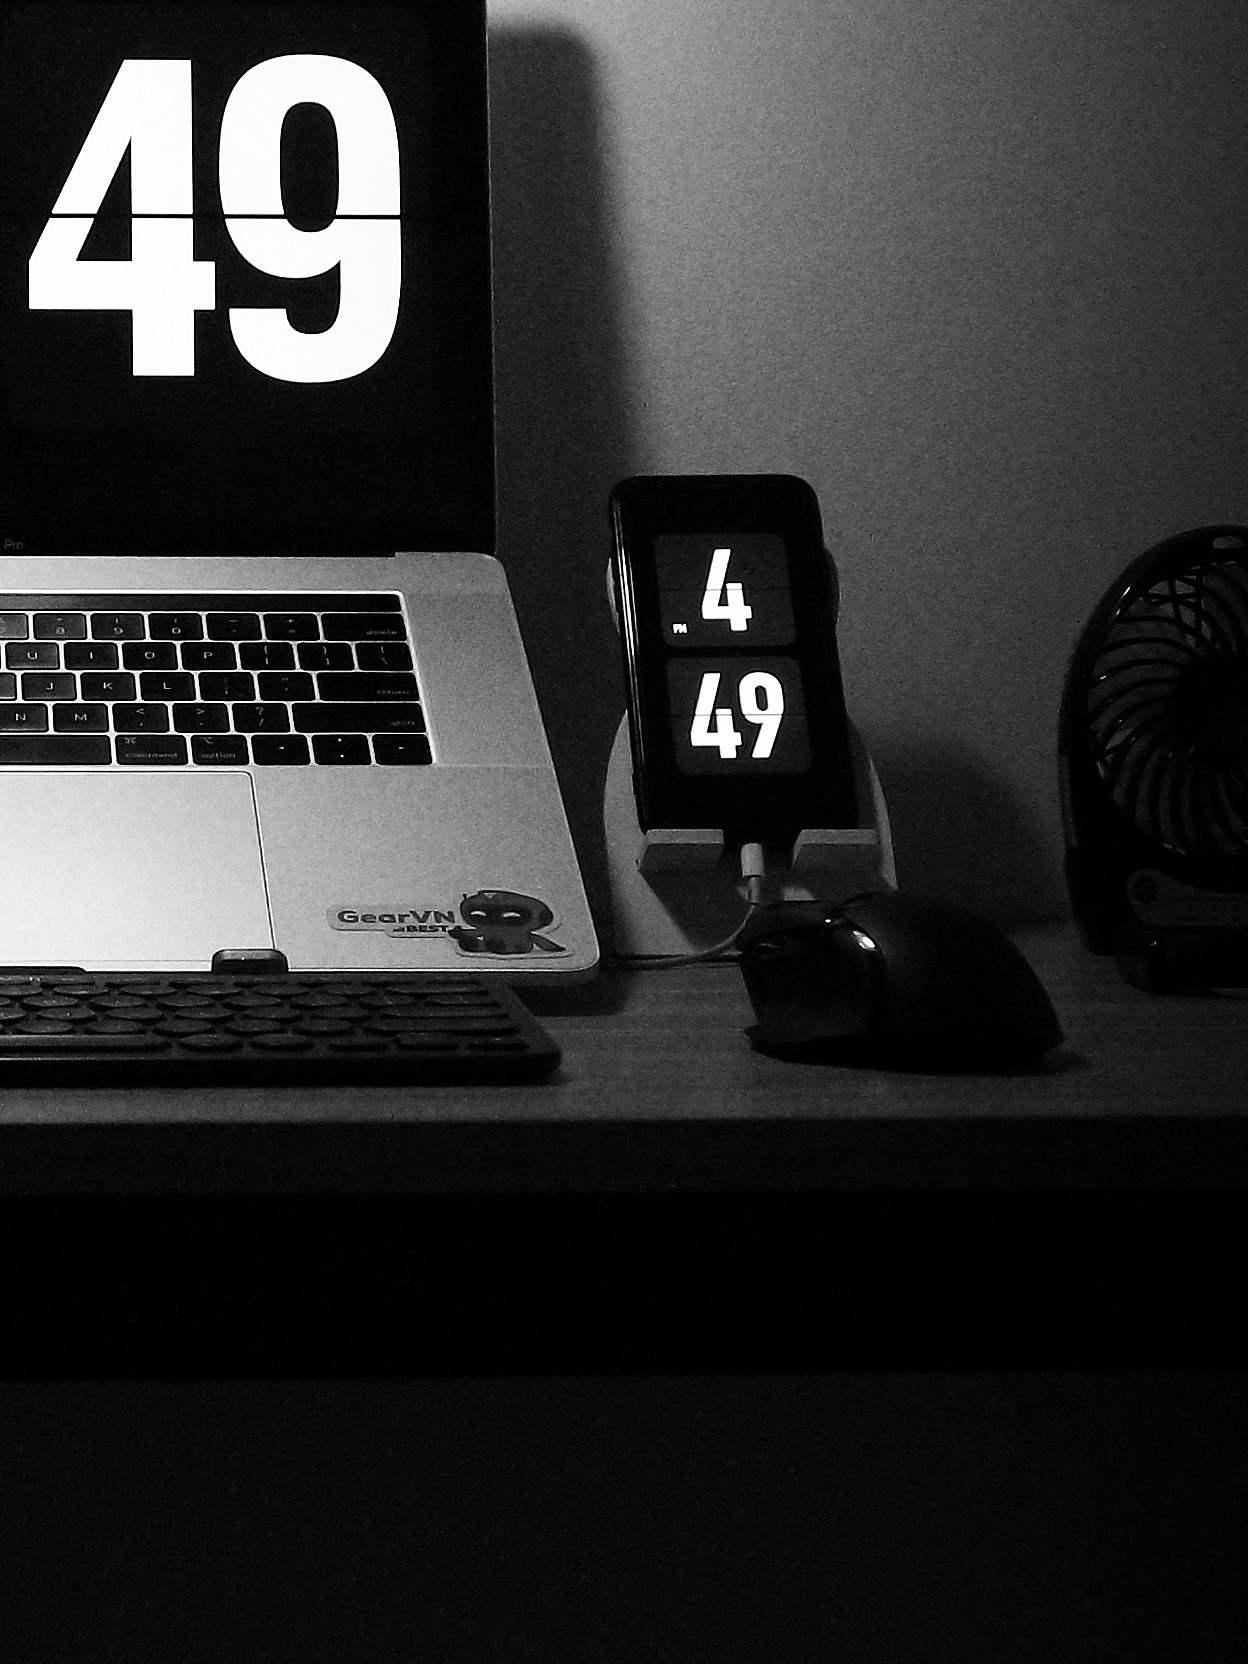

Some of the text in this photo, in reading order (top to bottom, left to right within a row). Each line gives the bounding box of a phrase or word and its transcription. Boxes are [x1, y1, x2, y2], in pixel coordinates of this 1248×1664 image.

[29, 54, 401, 383] 49
[4, 538, 24, 550] Pro
[702, 549, 752, 631] 4
[27, 651, 38, 660] U
[144, 650, 155, 660] O
[203, 650, 213, 660] P
[46, 682, 54, 691] J
[103, 681, 113, 690] K
[163, 681, 172, 690] L
[15, 712, 27, 722] N
[74, 712, 88, 722] M
[691, 672, 784, 758] 49
[337, 910, 455, 923] GearVN
